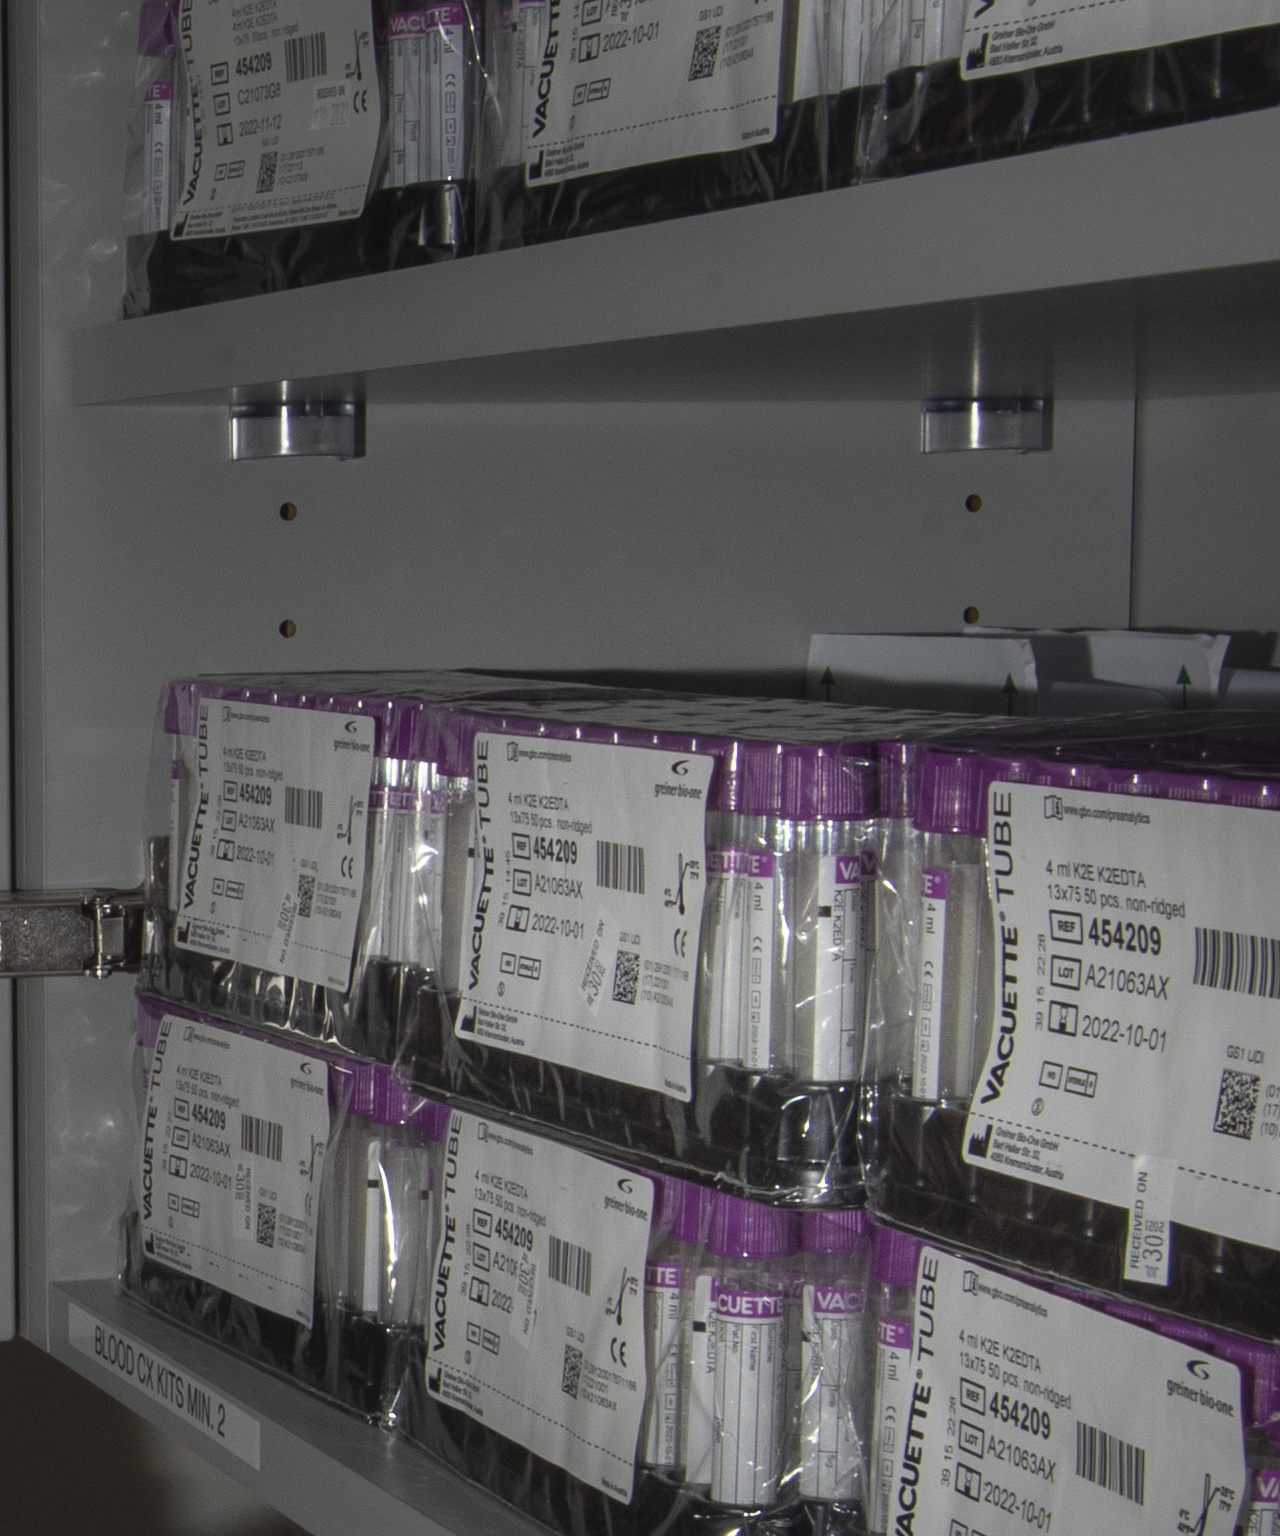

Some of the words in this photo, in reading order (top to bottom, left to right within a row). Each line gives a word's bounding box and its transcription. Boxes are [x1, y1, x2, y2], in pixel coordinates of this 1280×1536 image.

[603, 21, 659, 53] 2022-10-01
[235, 52, 272, 76] 454209
[239, 783, 272, 806] 454209
[476, 740, 491, 833] TUBE
[236, 845, 275, 867] 2022-10-01
[534, 836, 577, 864] 454209
[994, 792, 1014, 902] TUBE
[535, 874, 583, 899] A21063AX
[1046, 860, 1053, 875] 4
[1057, 862, 1070, 878] ml
[1073, 863, 1095, 881] K2E
[1098, 867, 1146, 889] K2EDTA
[1047, 884, 1081, 903] 13x75
[1084, 888, 1097, 905] 50
[1126, 897, 1185, 920] non-ridged
[532, 913, 584, 940] 2022-10-01
[1057, 920, 1075, 933] REF
[1089, 918, 1162, 956] 454209
[1058, 967, 1074, 980] LOT
[1085, 964, 1170, 1001] A21063AX
[1082, 1014, 1168, 1053] 2022-10-01
[151, 1021, 172, 1090] TUBE
[192, 1103, 226, 1130] 454209
[444, 1113, 463, 1199] TUBE
[190, 1163, 232, 1191] 2022-10-01
[495, 1217, 533, 1251] 454209
[1130, 1199, 1144, 1269] RECEIVED
[1137, 1171, 1148, 1193] ON
[917, 1256, 939, 1362] TUBE
[959, 1329, 965, 1343] 4
[967, 1334, 978, 1349] ml
[981, 1336, 1000, 1358] K2E
[1003, 1344, 1042, 1374] K2EDTA
[94, 1325, 135, 1376] BLOOD
[137, 1353, 154, 1390] CX
[157, 1364, 184, 1409] KITS
[188, 1382, 214, 1430] MIN.
[217, 1403, 226, 1438] 2
[960, 1352, 986, 1375] 13x75
[989, 1362, 1000, 1380] 50
[1023, 1379, 1071, 1410] non-ridged
[1166, 1379, 1199, 1406] greiner
[1200, 1390, 1234, 1418] bio-one
[966, 1388, 980, 1402] REF
[990, 1392, 1051, 1439] 454209
[965, 1432, 979, 1447] LOT
[987, 1435, 1056, 1484] A21063AX
[984, 1481, 1052, 1533] 2022-10-01
[1249, 1508, 1260, 1534] K2E
